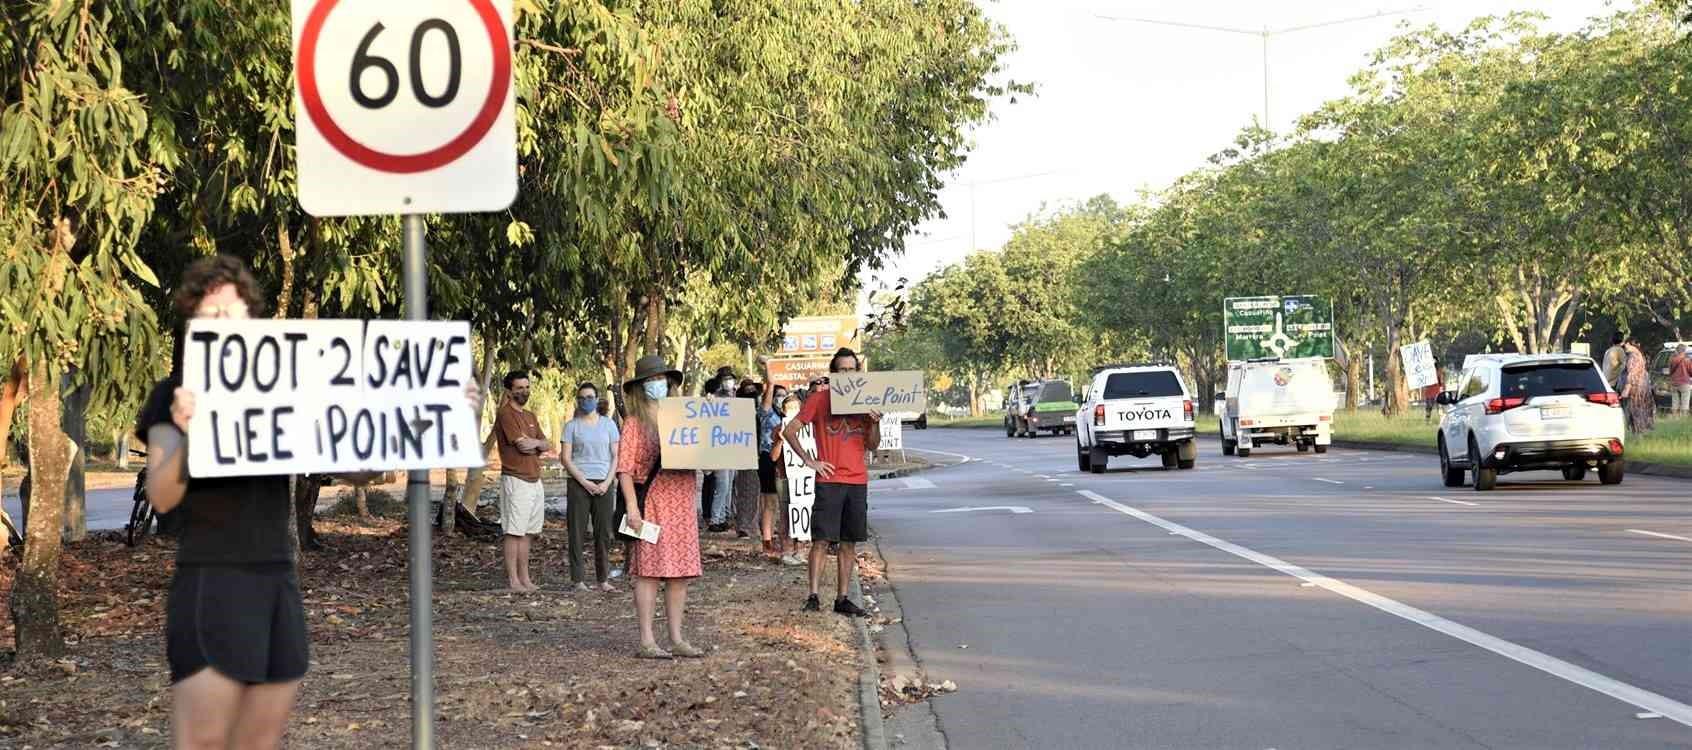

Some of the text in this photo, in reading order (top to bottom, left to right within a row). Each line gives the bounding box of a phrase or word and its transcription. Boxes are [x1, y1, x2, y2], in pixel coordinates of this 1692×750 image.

[349, 18, 462, 109] 60
[191, 331, 466, 392] TOOT 2 SAVE
[831, 377, 868, 397] Vote
[851, 390, 880, 406] Lee
[685, 400, 731, 419] SAVE
[1117, 409, 1172, 421] TOYOTA
[211, 404, 452, 464] LEE POINT
[669, 425, 754, 448] LEE POINT
[794, 475, 813, 497] LE
[791, 506, 811, 535] PO
